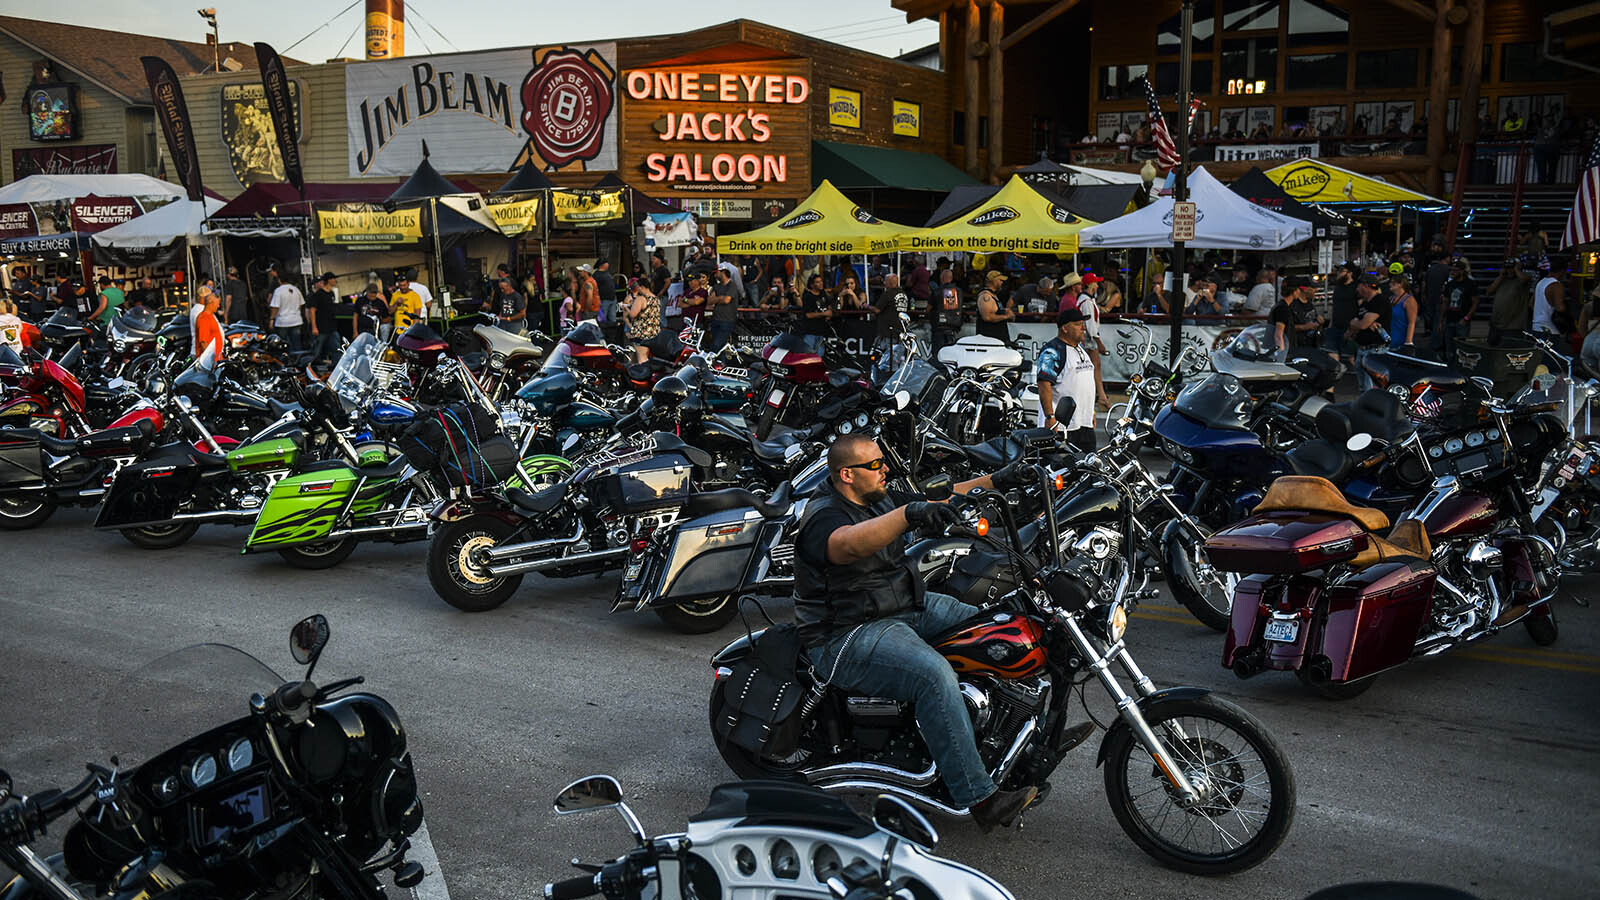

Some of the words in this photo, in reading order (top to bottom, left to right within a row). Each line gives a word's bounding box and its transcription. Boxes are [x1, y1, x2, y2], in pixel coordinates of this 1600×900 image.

[548, 74, 565, 93] JIM
[568, 73, 593, 106] BEAM
[627, 70, 809, 103] ONE-EYED
[357, 84, 410, 175] JIM
[412, 62, 517, 136] BEAM
[541, 103, 562, 140] SINCE
[566, 118, 589, 140] 1795
[659, 108, 771, 142] JACK'S
[1257, 149, 1297, 160] WELCOME
[646, 153, 787, 183] SALOON
[1285, 173, 1327, 190] mike's
[0, 211, 29, 223] LENCER
[75, 205, 133, 217] SILENCER
[495, 206, 534, 220] NOODLES
[974, 209, 1015, 224] mike's
[4, 222, 29, 230] CENTRAL
[98, 216, 132, 224] CENTRAL
[323, 217, 355, 229] ISLAND
[372, 215, 416, 228] NOODLES
[783, 212, 820, 227] mike's
[1, 243, 20, 254] BUY
[20, 241, 27, 252] A
[28, 238, 71, 252] SILENCER
[729, 240, 757, 251] Drink
[759, 243, 773, 251] on
[776, 241, 792, 251] the
[795, 240, 827, 254] bright
[830, 241, 852, 252] side
[870, 240, 884, 250] Drink
[885, 240, 893, 249] on
[912, 236, 944, 248] Drink
[948, 239, 962, 248] on
[972, 236, 988, 247] the
[990, 236, 1029, 250] bright
[1032, 238, 1059, 250] side
[751, 335, 772, 343] PUREST
[1161, 338, 1171, 361] WHIT
[1180, 332, 1205, 347] CLAW
[1268, 624, 1293, 636] AZTECA
